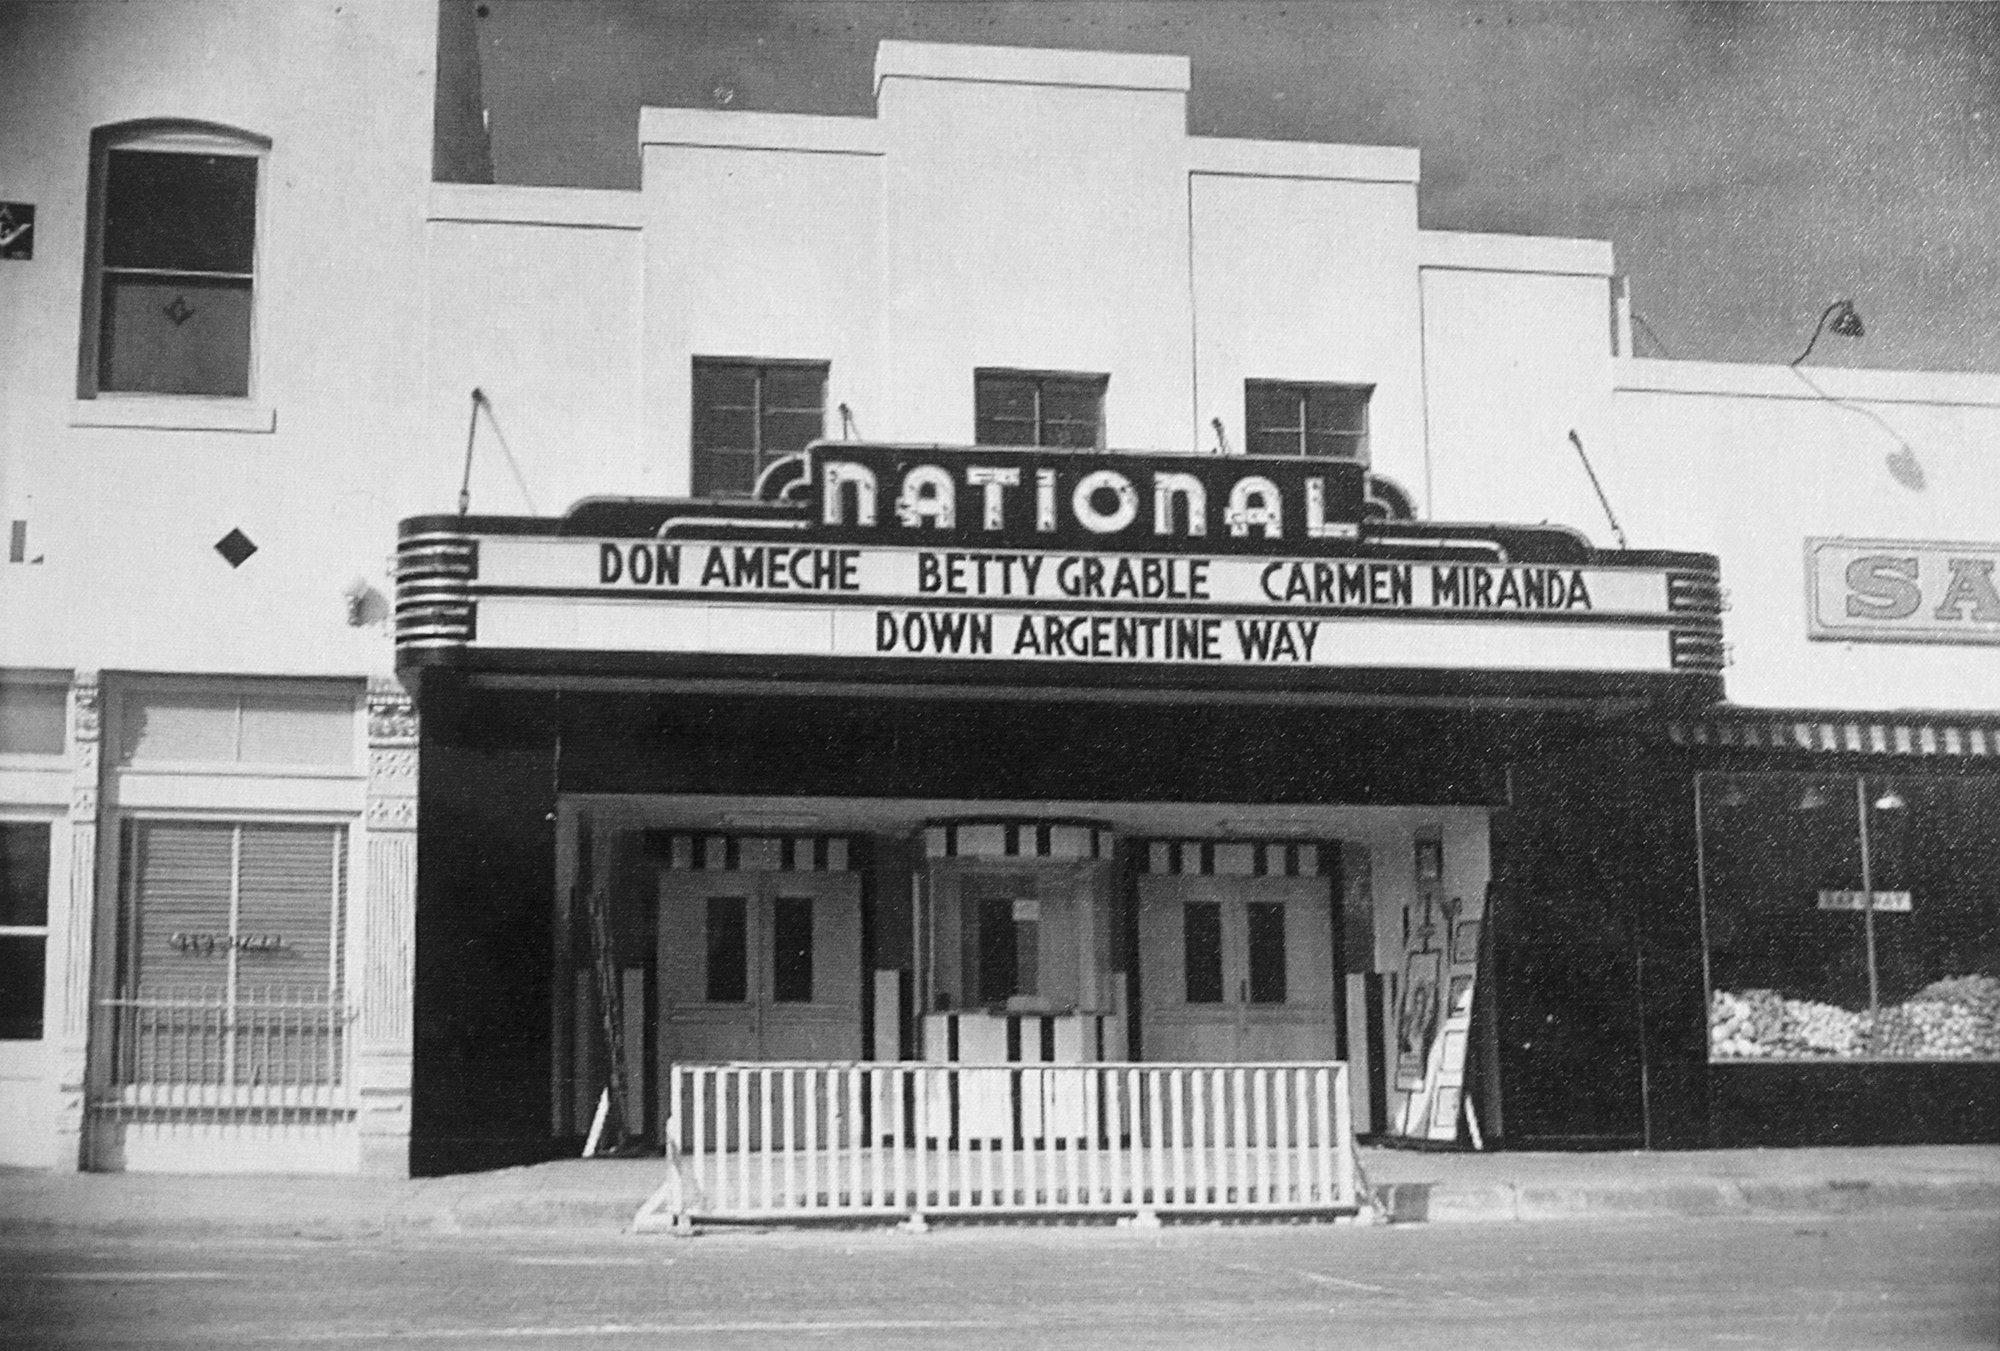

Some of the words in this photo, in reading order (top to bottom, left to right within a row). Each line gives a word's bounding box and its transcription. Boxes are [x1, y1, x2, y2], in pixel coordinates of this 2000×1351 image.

[822, 461, 1358, 539] NATIONAL
[600, 542, 682, 587] DON
[701, 545, 860, 591] AMECHE
[918, 551, 1043, 596] BETTY
[1056, 555, 1210, 600] GRABLE
[1260, 560, 1413, 606] CARMEN
[1431, 564, 1592, 611] MIRANDA
[876, 610, 993, 655] DOWN
[1012, 614, 1221, 661] ARGENTINE
[1235, 618, 1320, 664] WAY
